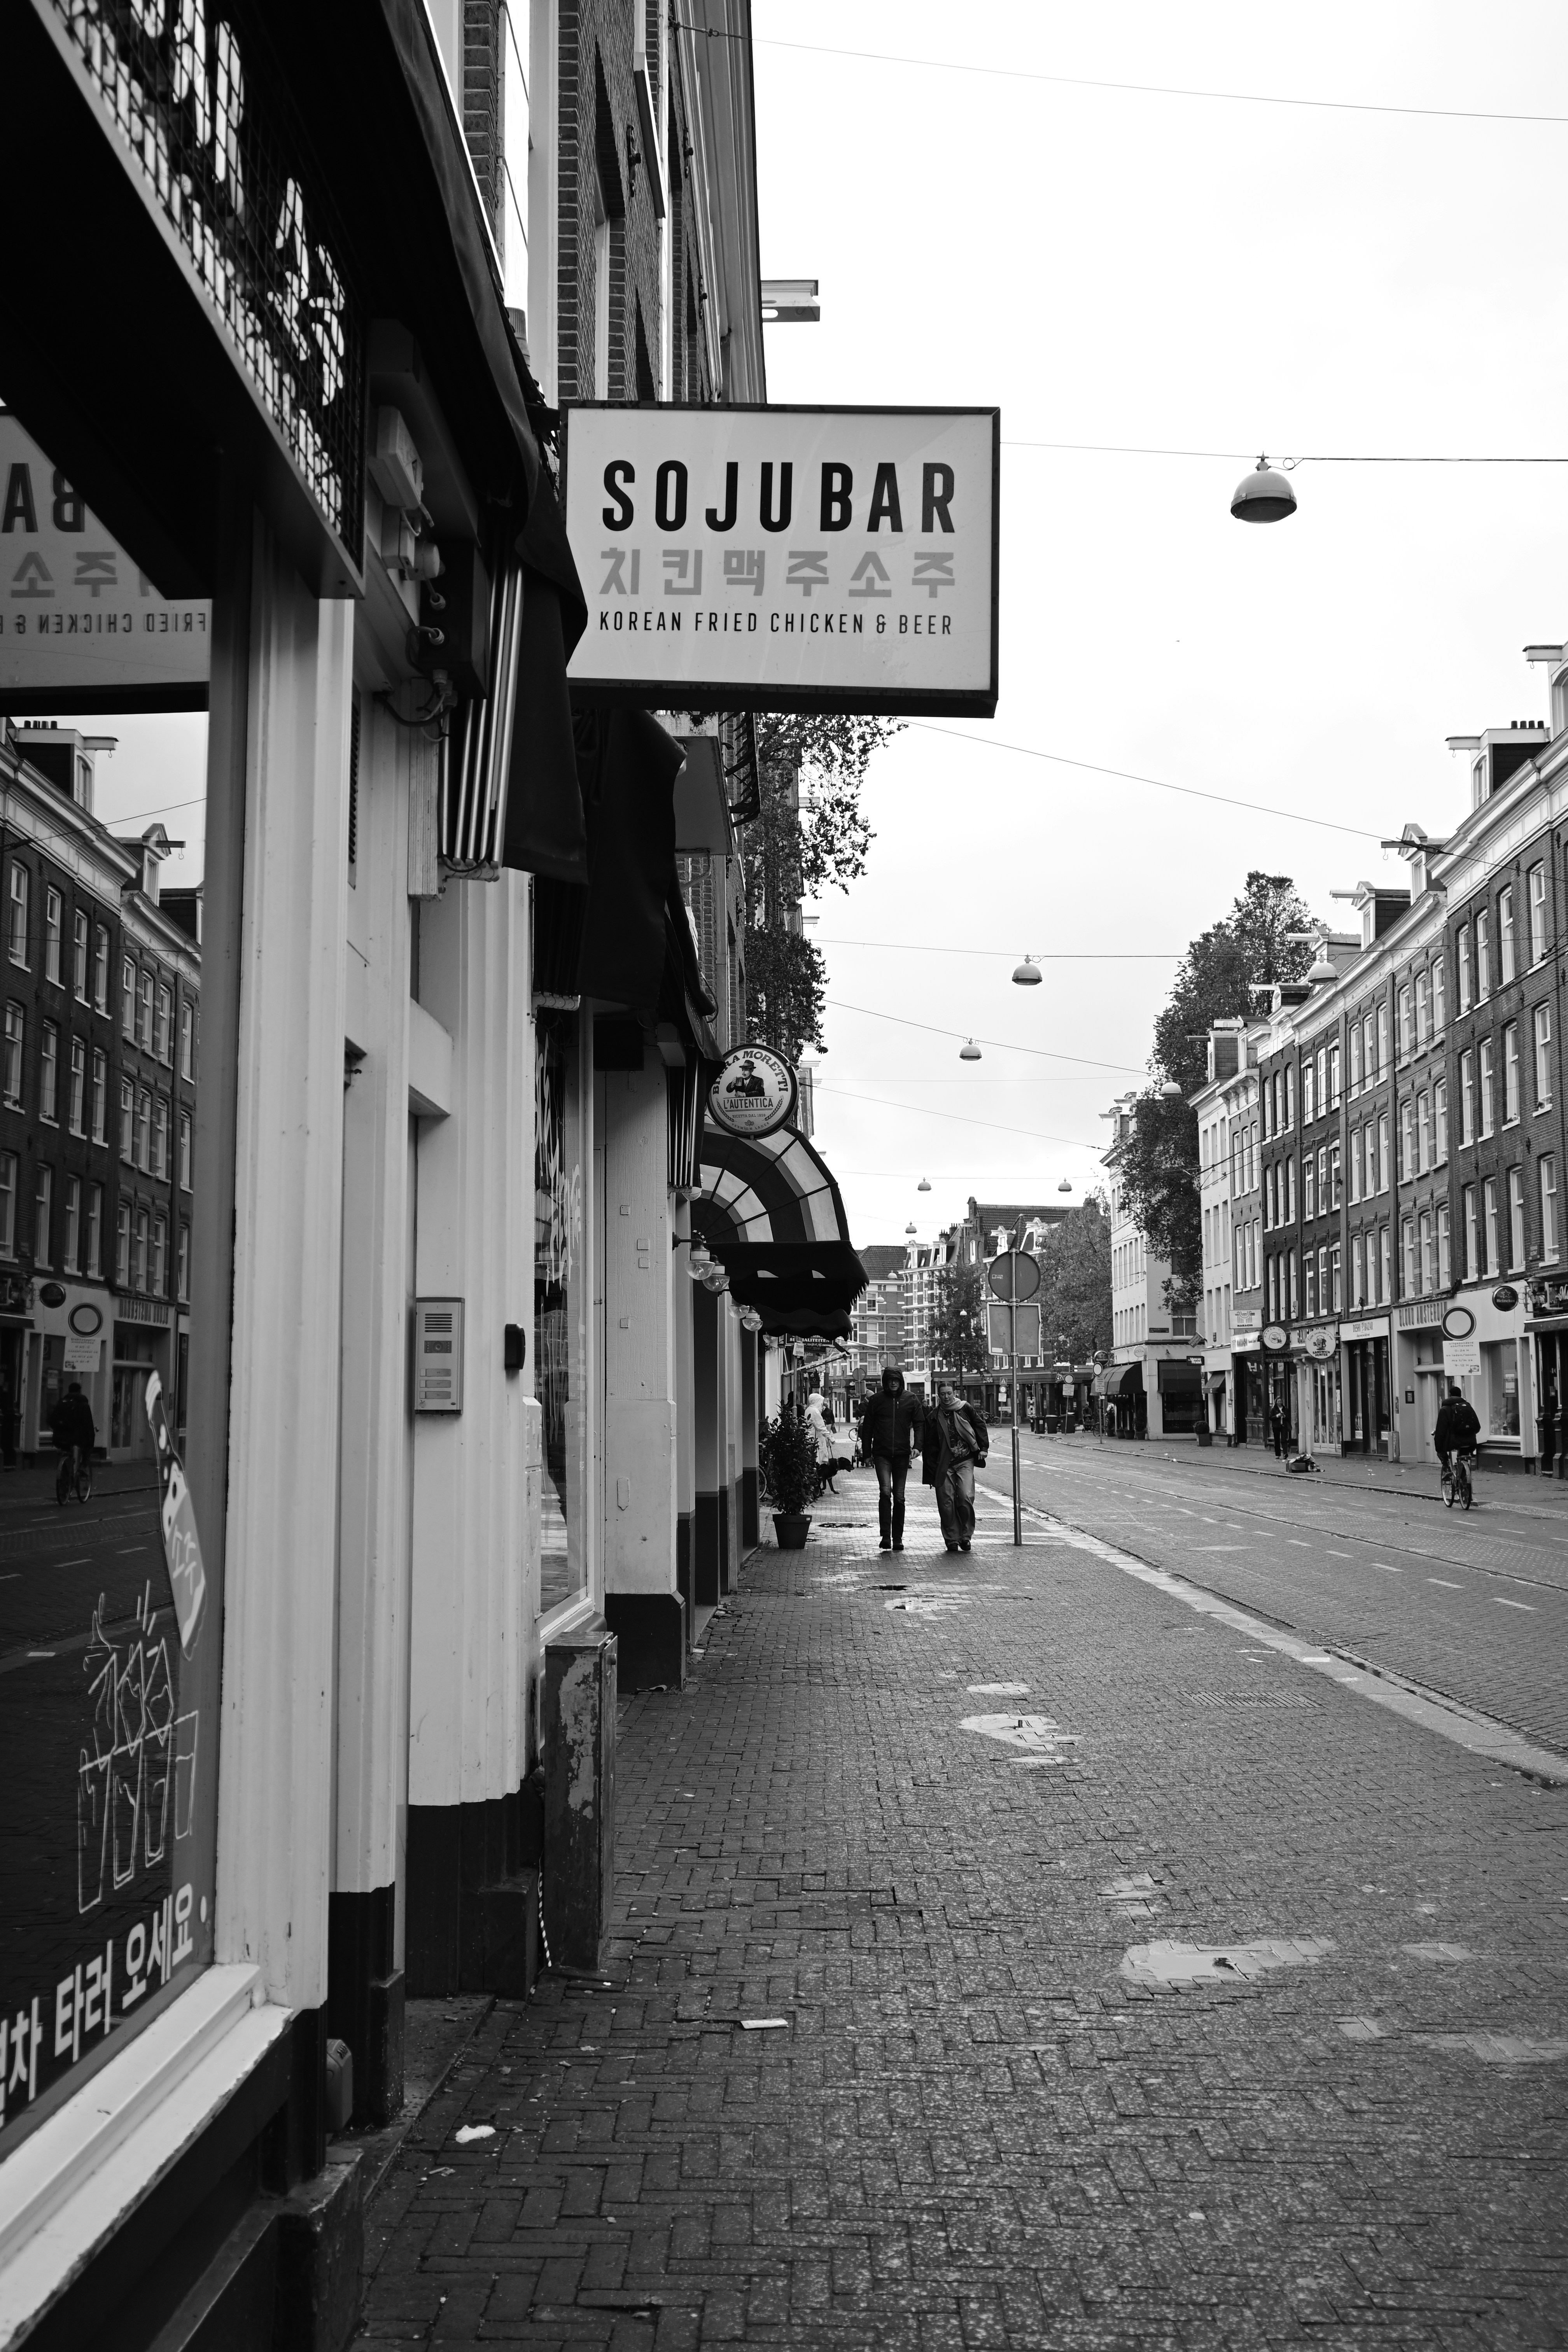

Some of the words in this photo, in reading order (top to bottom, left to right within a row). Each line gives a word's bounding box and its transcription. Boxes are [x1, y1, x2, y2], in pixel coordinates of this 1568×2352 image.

[599, 611, 681, 632] KOREAN
[695, 612, 758, 632] FRIED
[770, 612, 863, 634] CHICKEN
[876, 614, 887, 635] &
[899, 614, 952, 635] BEER
[742, 1050, 789, 1092] MORETTI
[723, 1097, 774, 1110] L'AUTENTICA
[754, 1122, 770, 1130] LAGER
[172, 1524, 197, 1595] 소주
[55, 1939, 113, 2063] 타러
[122, 1883, 207, 2010] 오세요.
